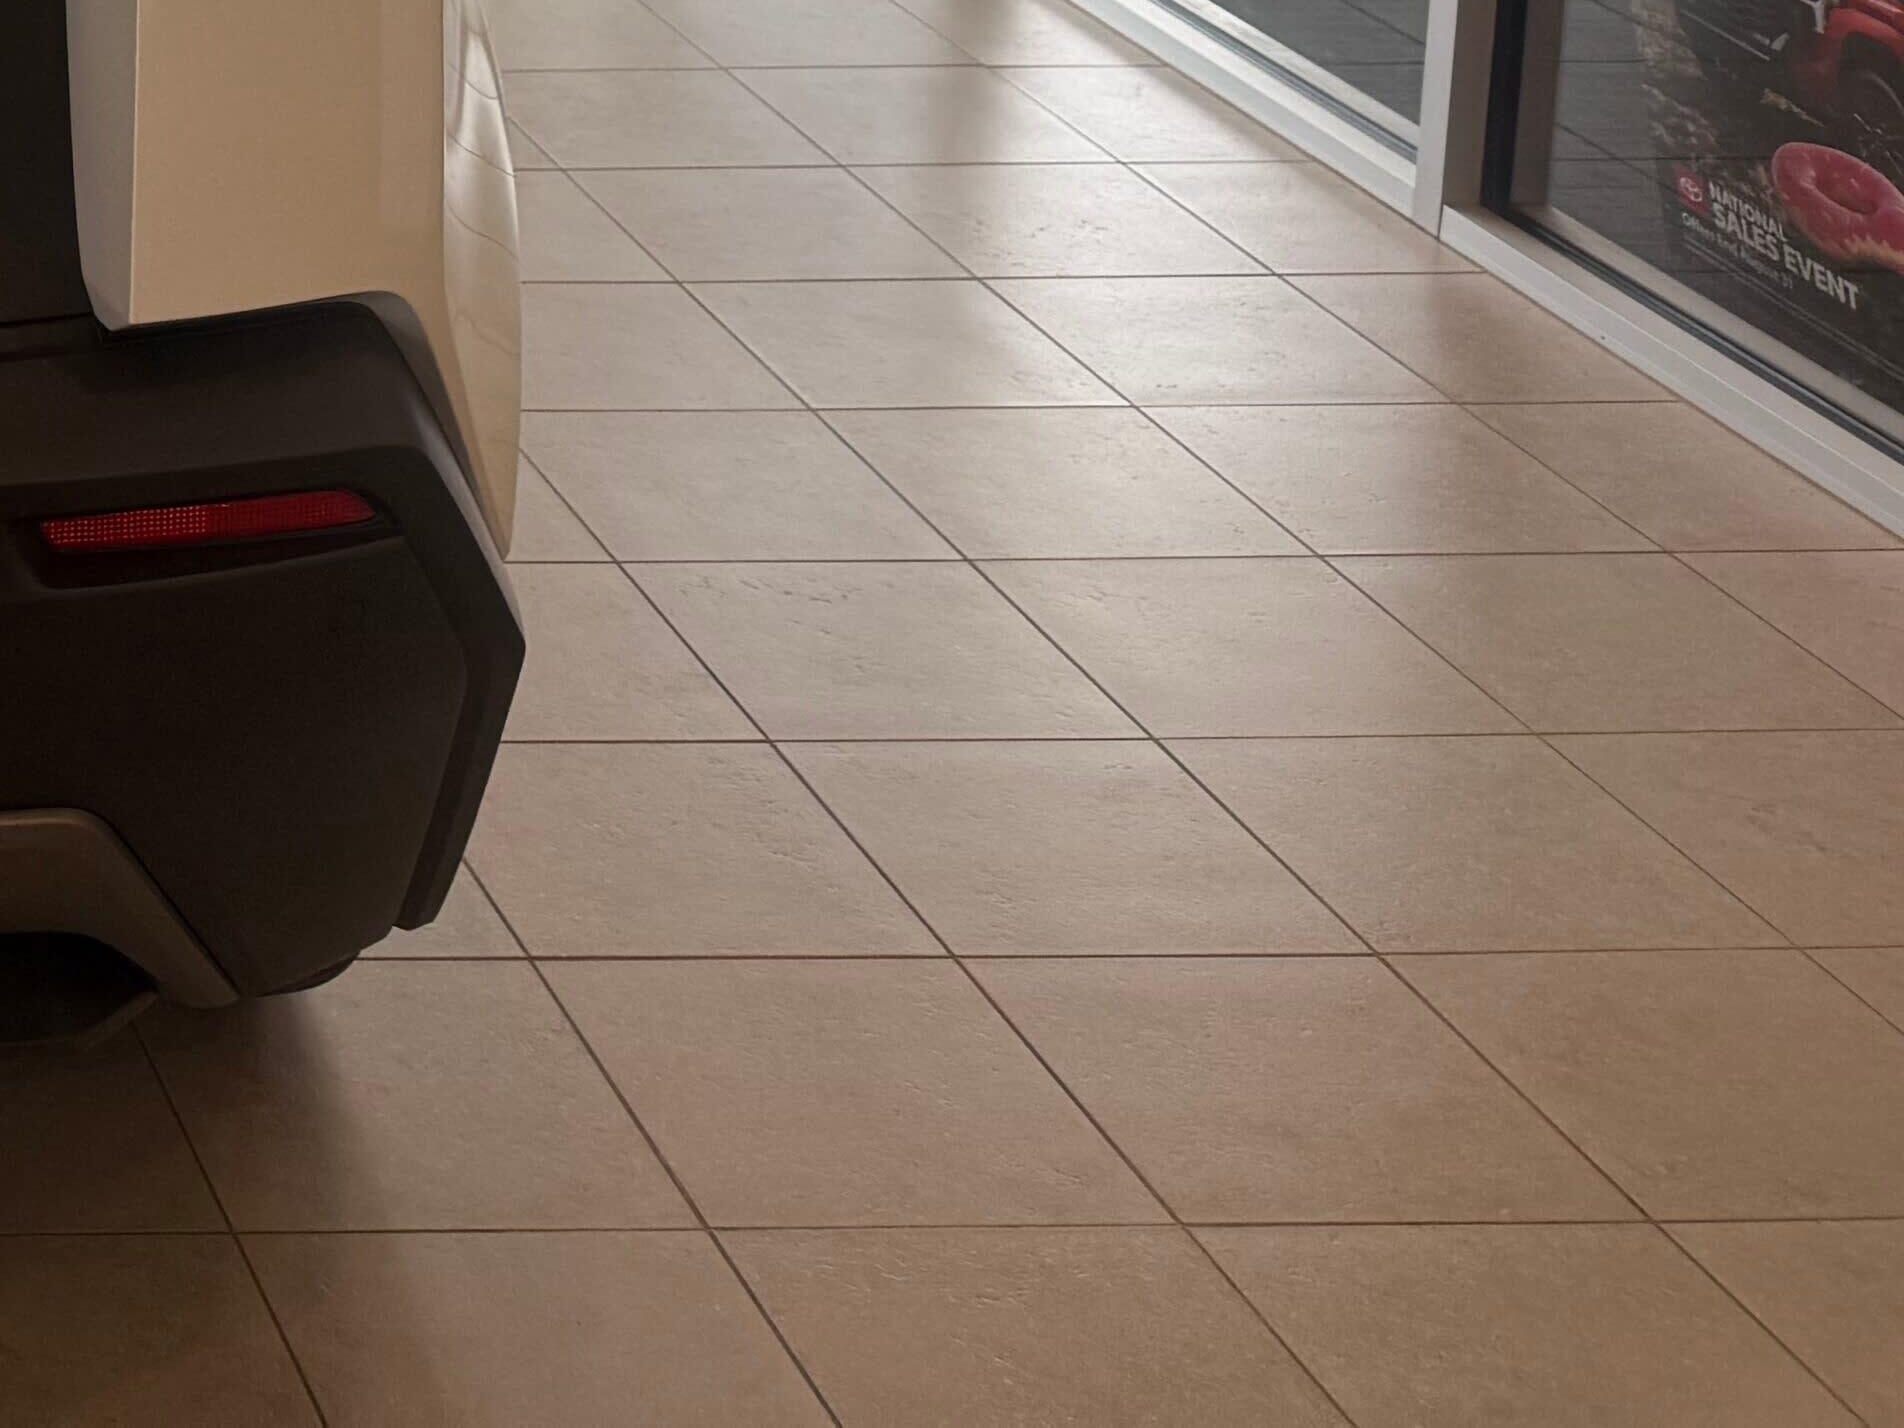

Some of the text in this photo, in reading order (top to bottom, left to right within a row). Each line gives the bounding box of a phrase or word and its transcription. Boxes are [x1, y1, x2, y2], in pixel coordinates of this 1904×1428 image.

[1708, 180, 1789, 243] NATIONAL
[1712, 202, 1860, 311] SALES EVENT
